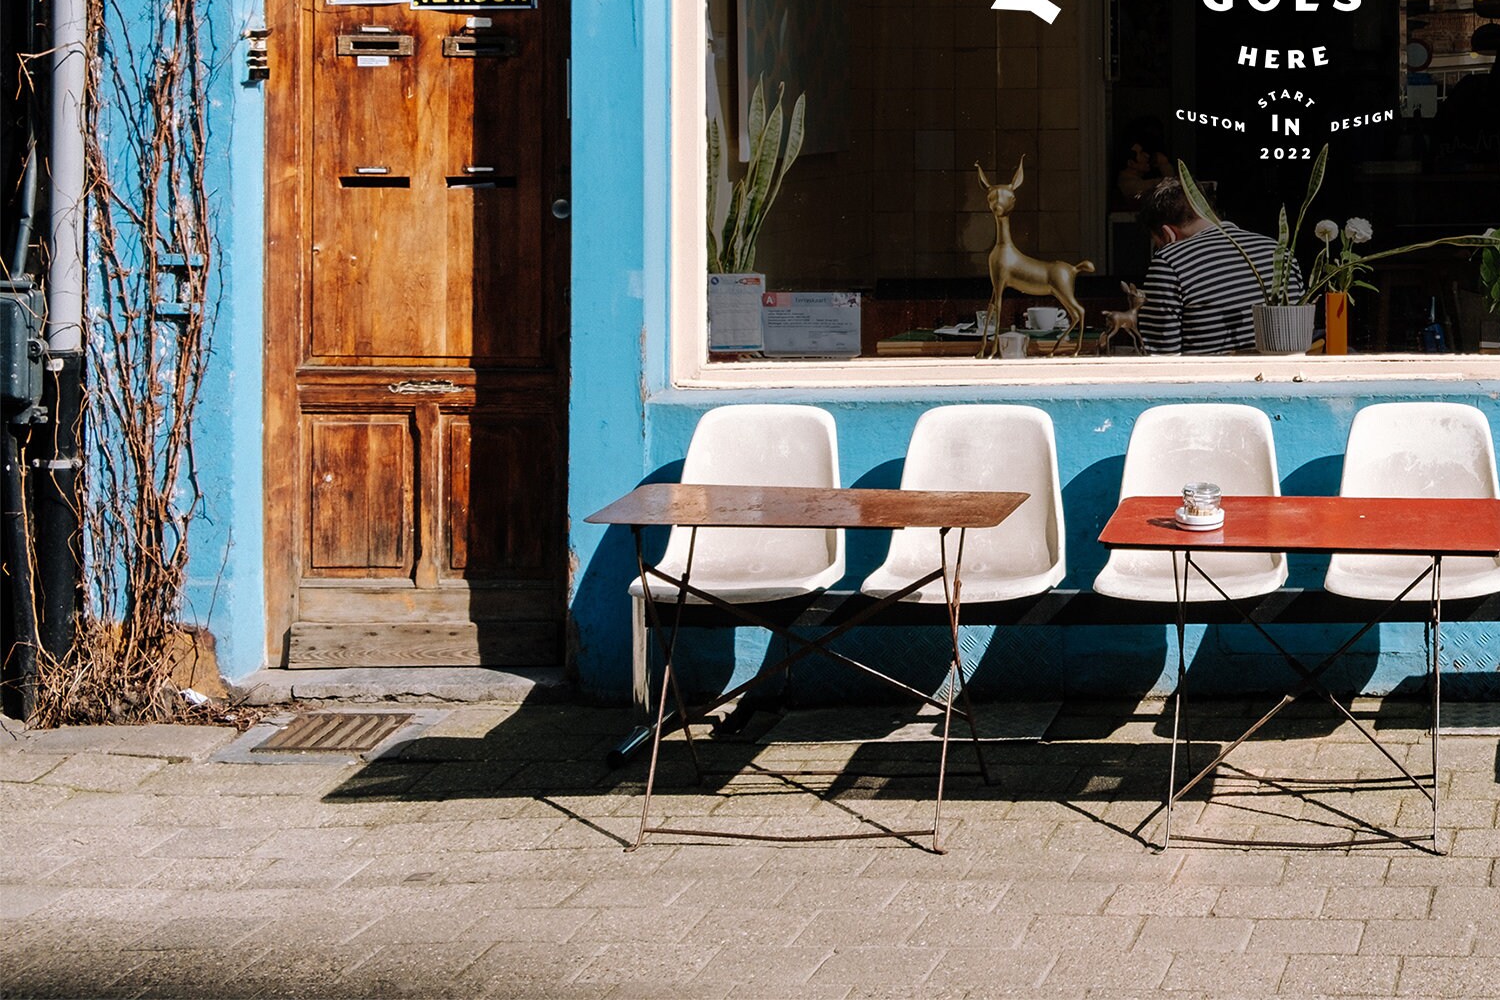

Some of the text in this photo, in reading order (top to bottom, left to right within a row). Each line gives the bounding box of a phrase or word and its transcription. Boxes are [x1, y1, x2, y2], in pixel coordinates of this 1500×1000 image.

[1237, 45, 1329, 69] HERE
[1257, 89, 1316, 109] START
[1176, 109, 1246, 133] CUSTOM
[1271, 114, 1300, 136] IN
[1330, 109, 1394, 132] DESIGN
[1259, 147, 1311, 160] 2022
